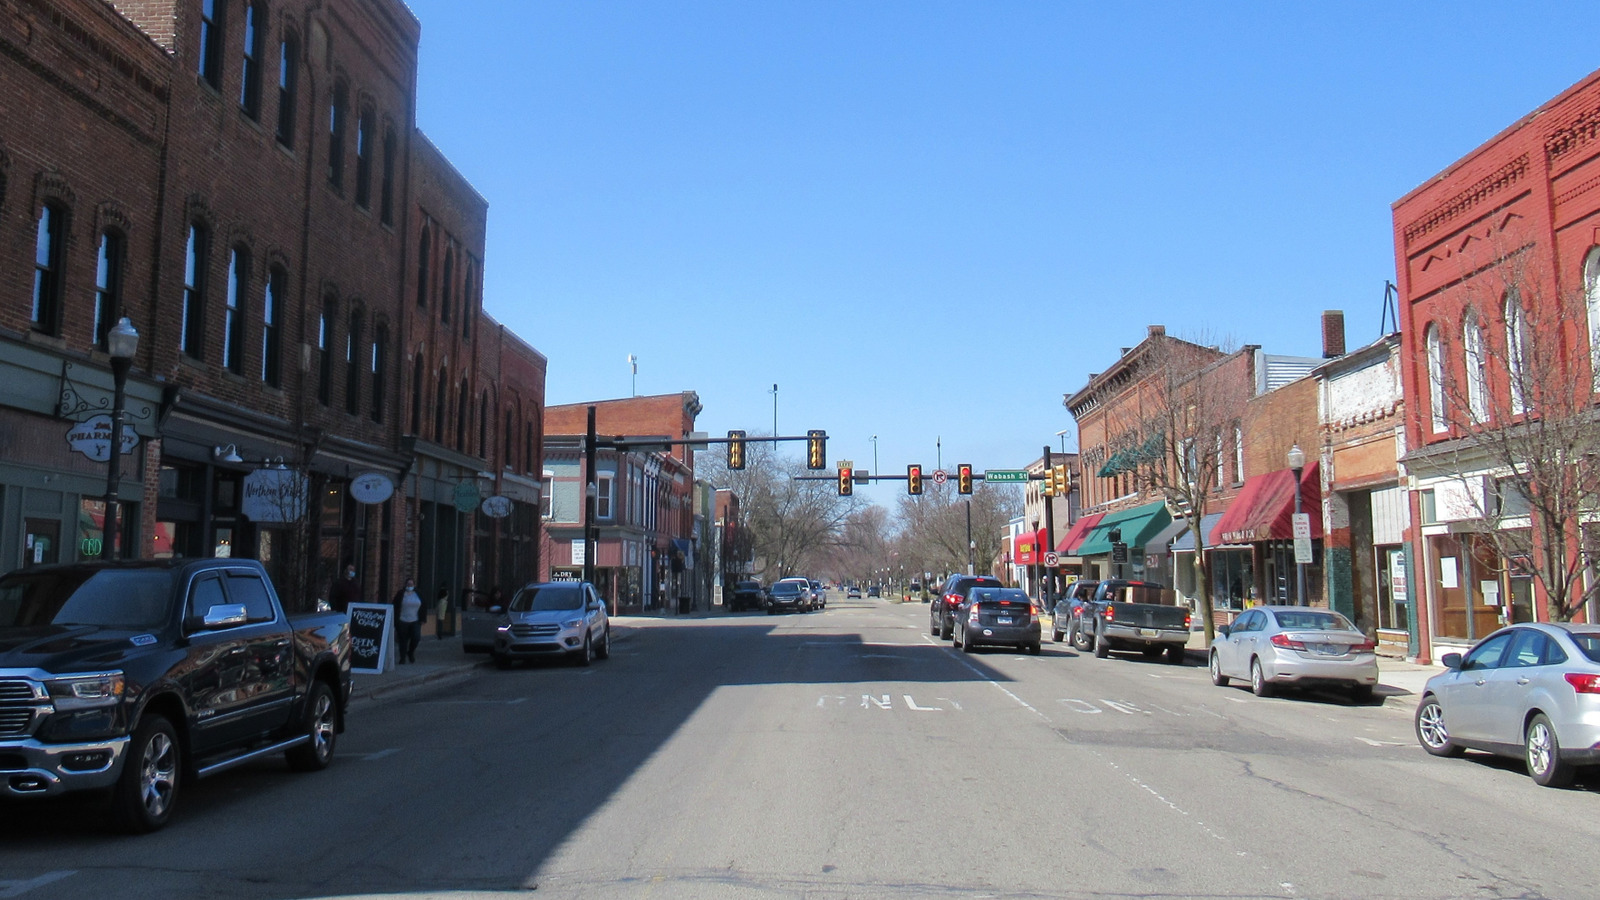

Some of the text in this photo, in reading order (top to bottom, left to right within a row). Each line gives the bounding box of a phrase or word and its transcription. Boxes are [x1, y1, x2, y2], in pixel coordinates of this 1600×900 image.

[70, 432, 134, 444] PHARMCY
[245, 481, 277, 498] Northern
[81, 538, 102, 556] CBD
[351, 636, 375, 647] OPEN
